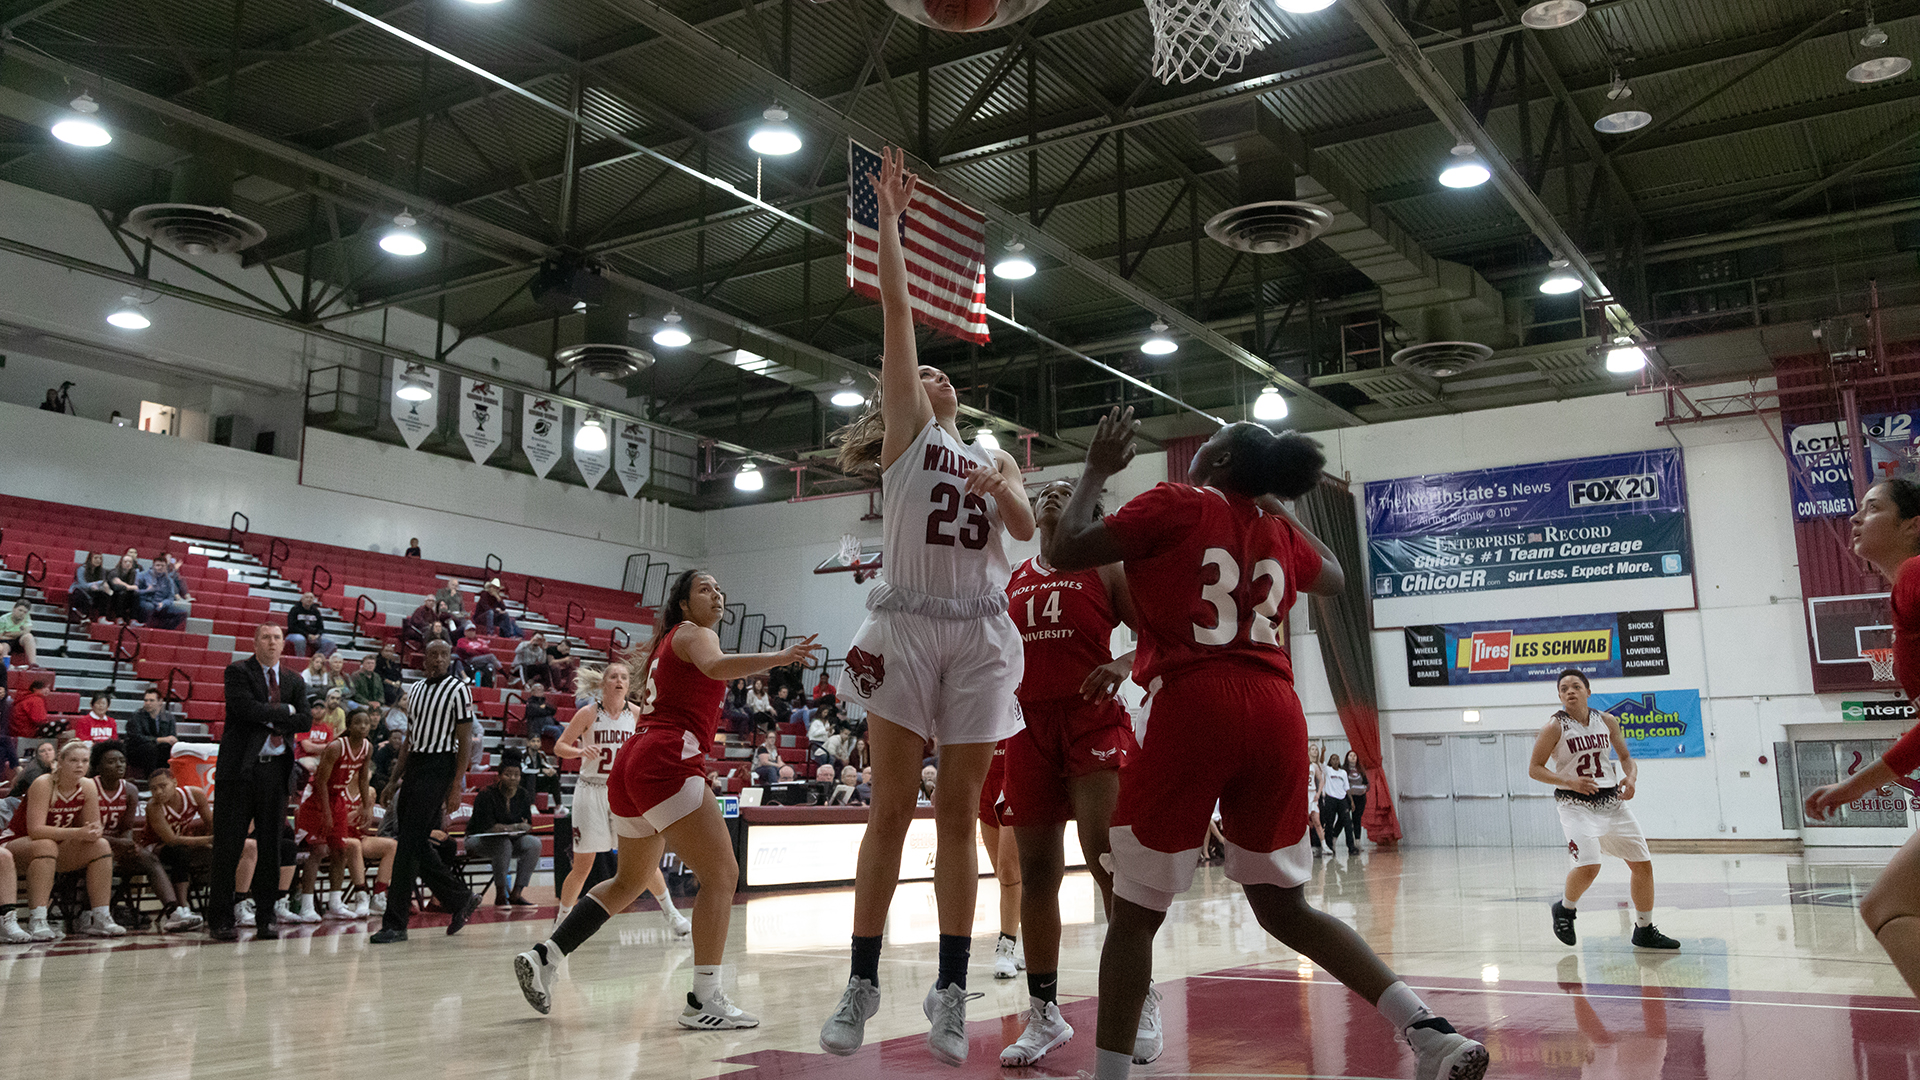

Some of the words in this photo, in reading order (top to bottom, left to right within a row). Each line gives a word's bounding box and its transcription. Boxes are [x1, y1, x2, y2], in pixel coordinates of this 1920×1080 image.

[923, 444, 978, 479] WILD
[1378, 496, 1402, 510] The
[1407, 483, 1508, 507] Northstate's
[1512, 481, 1552, 496] News
[926, 482, 990, 550] 23
[1418, 513, 1448, 526] Airing
[1450, 510, 1484, 525] Nightly
[1435, 533, 1526, 551] ENTERPRISE
[1545, 526, 1612, 543] RECORD
[1414, 552, 1474, 569] Chico's
[1480, 549, 1503, 564] #1
[1509, 546, 1555, 562] Team
[1560, 539, 1643, 557] Coverage
[1508, 569, 1534, 583] Surf
[1537, 567, 1568, 580] Less.
[1572, 563, 1615, 579] Expect
[1617, 561, 1653, 575] More.
[1011, 584, 1038, 599] HOLY
[1040, 580, 1083, 590] NAMES
[1192, 547, 1285, 647] 32
[1025, 590, 1063, 627] 14
[1627, 622, 1654, 630] SHOCKS
[1021, 629, 1075, 642] NIVERSITY
[1417, 635, 1434, 643] TIRES
[1630, 634, 1655, 643] LIFTING
[1414, 647, 1439, 655] WHEELS
[1474, 639, 1509, 663] Tires
[1515, 641, 1539, 658] LES
[1542, 638, 1607, 657] SCHWAB
[1626, 646, 1661, 655] LOWERING
[1412, 658, 1443, 667] BATTERIES
[1625, 659, 1665, 668] ALIGNMENT
[1416, 670, 1440, 678] BRAKES
[1845, 705, 1916, 718] enterp
[90, 727, 112, 737] HNU
[1620, 726, 1680, 741] ing.com
[1566, 734, 1610, 754] WILDCATS
[1576, 752, 1605, 778] 21
[726, 803, 737, 812] APP
[1849, 798, 1908, 813] CHICO
